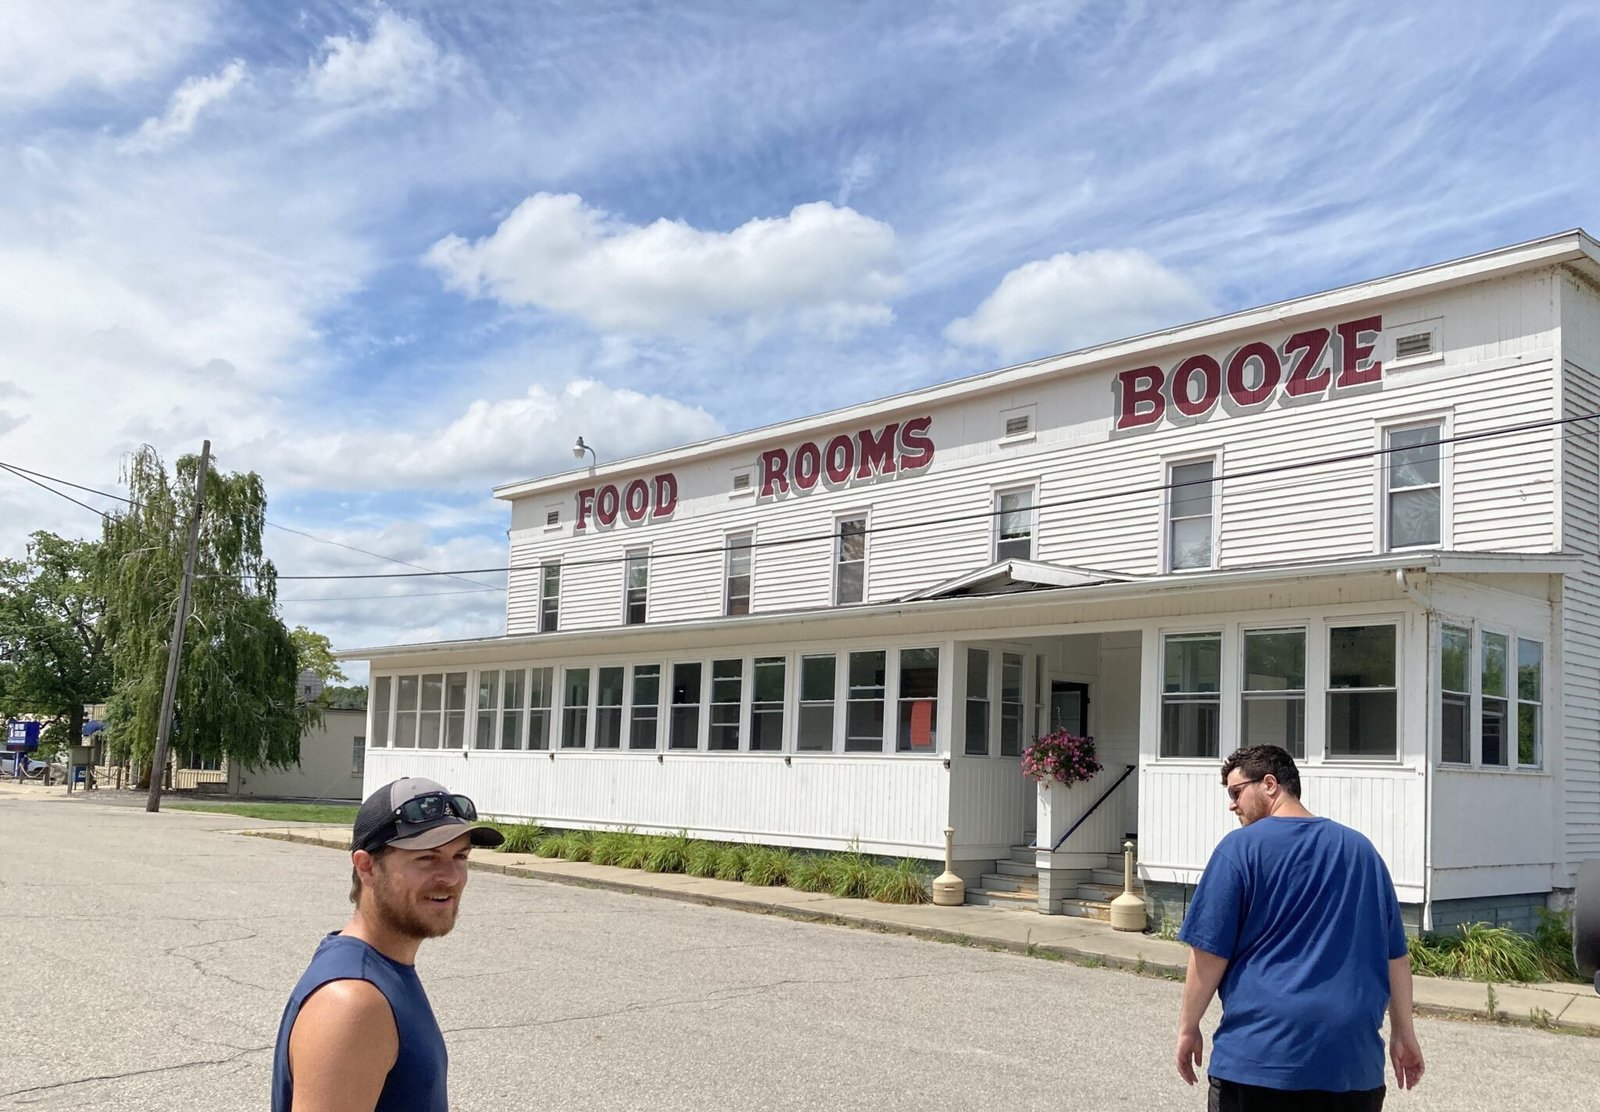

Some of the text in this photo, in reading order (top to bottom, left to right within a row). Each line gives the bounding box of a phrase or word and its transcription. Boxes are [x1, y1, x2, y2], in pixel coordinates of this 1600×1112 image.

[575, 314, 1383, 530] FOOD ROOMS BOOZE
